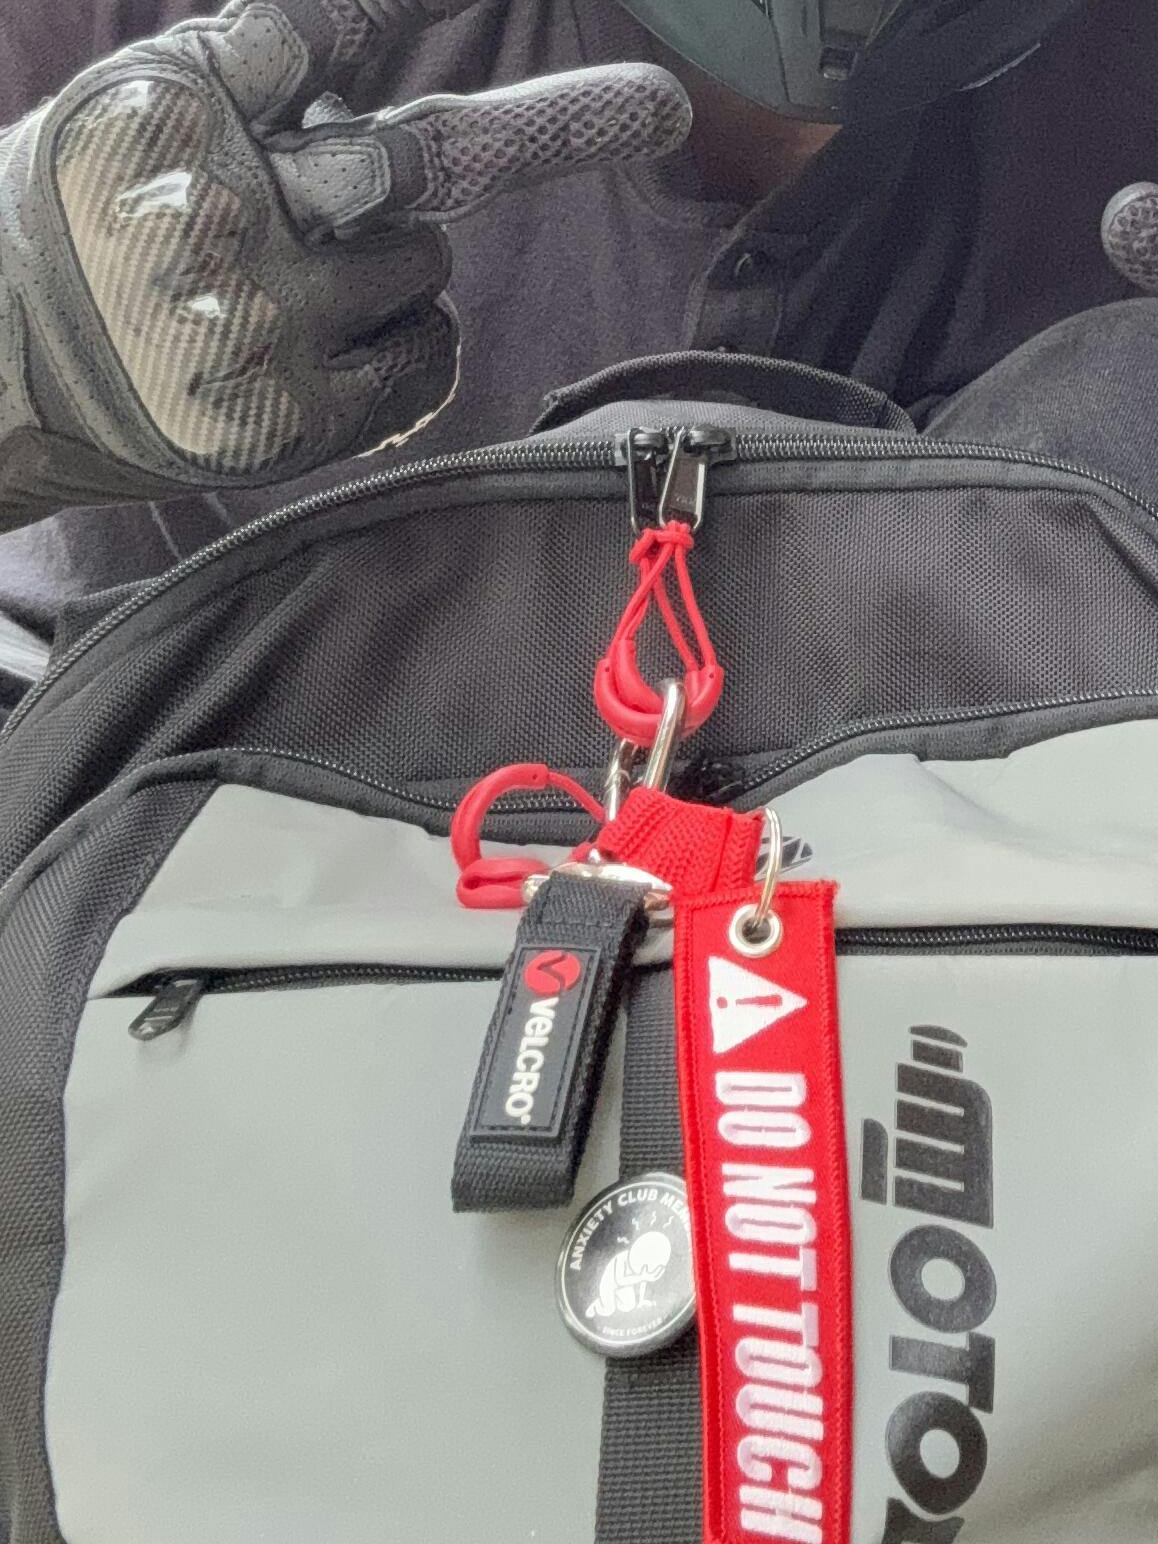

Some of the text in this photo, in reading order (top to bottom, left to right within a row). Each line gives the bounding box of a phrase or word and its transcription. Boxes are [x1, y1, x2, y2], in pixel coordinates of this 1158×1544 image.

[570, 1200, 613, 1270] ANXIETY
[617, 1188, 658, 1206] CLUB
[715, 1071, 824, 1544] DO NOT TOUCH
